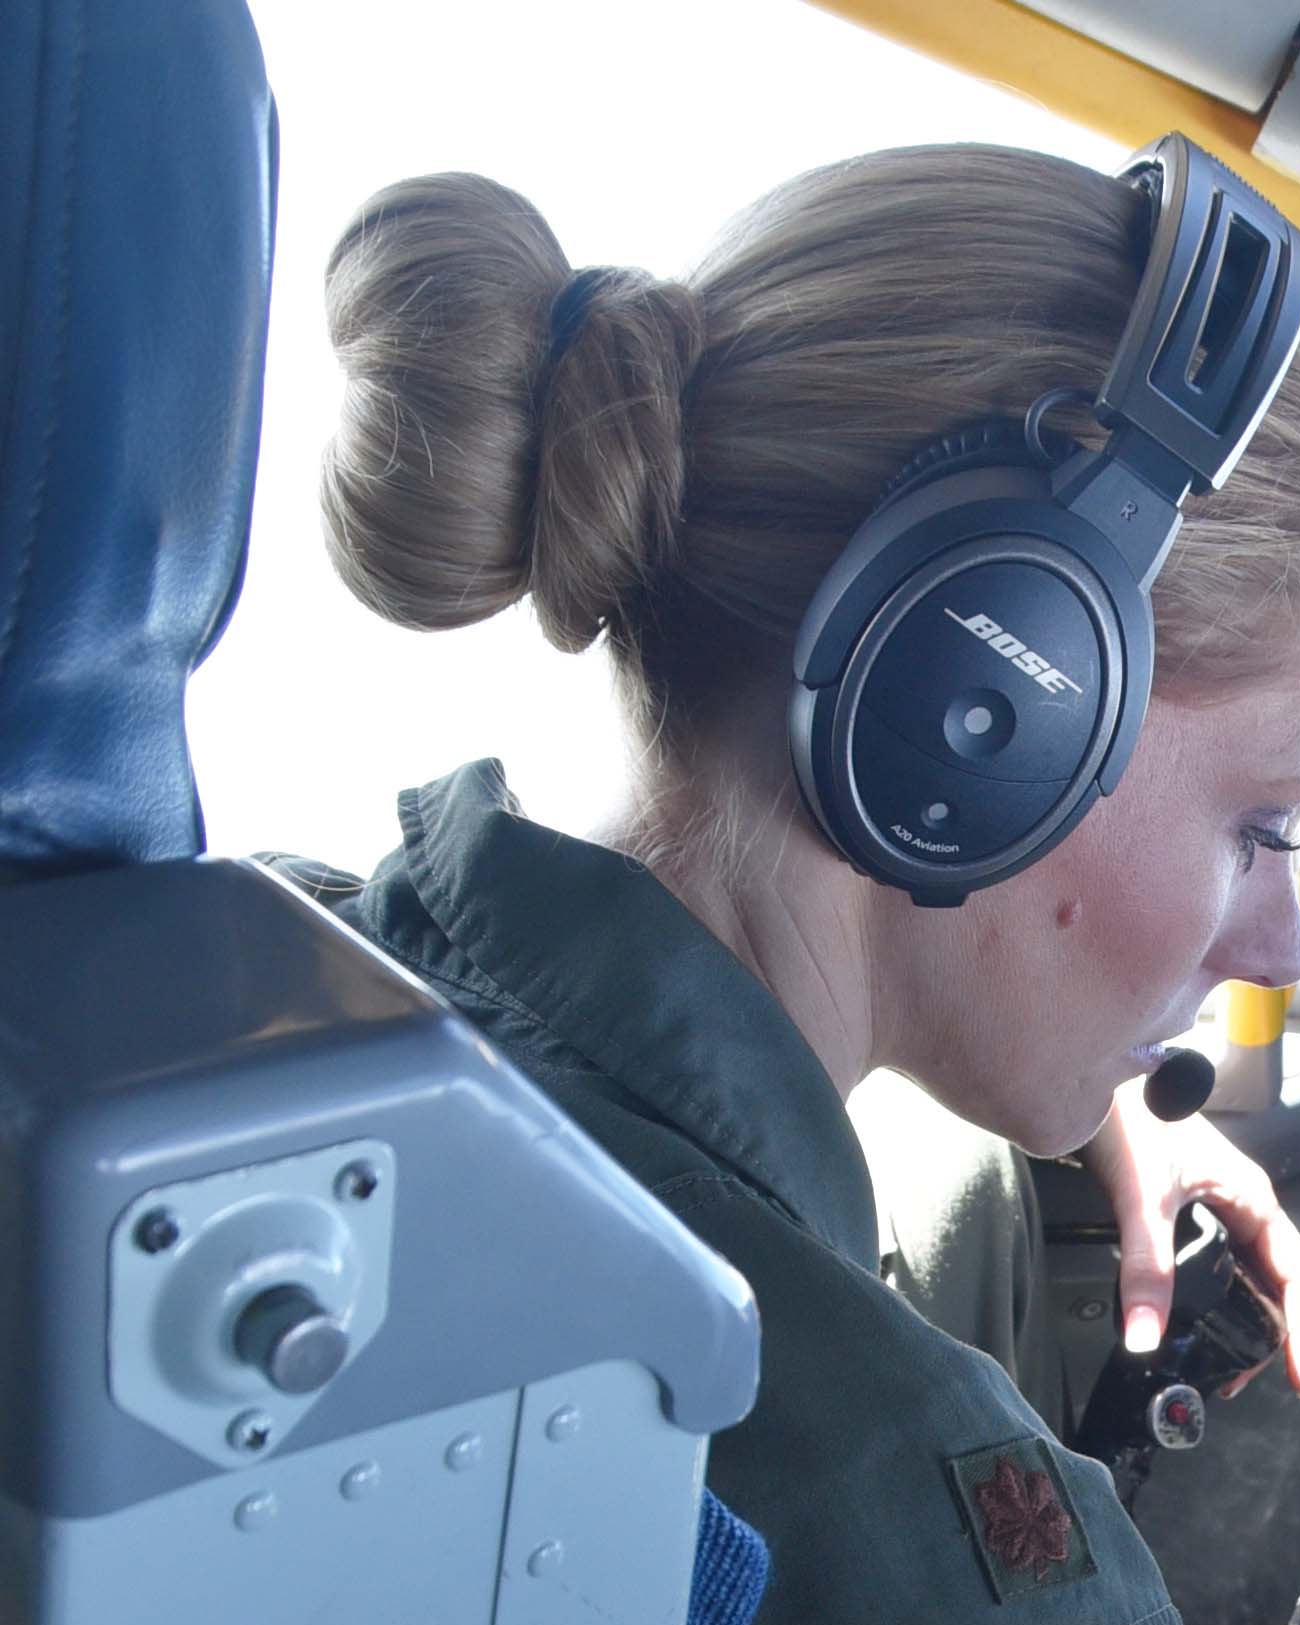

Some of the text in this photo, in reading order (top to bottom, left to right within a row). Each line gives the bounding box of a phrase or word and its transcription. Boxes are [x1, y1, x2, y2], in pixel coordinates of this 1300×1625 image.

[1119, 500, 1137, 521] R
[944, 607, 1082, 694] BOSE
[890, 823, 960, 853] A20 Aviation
